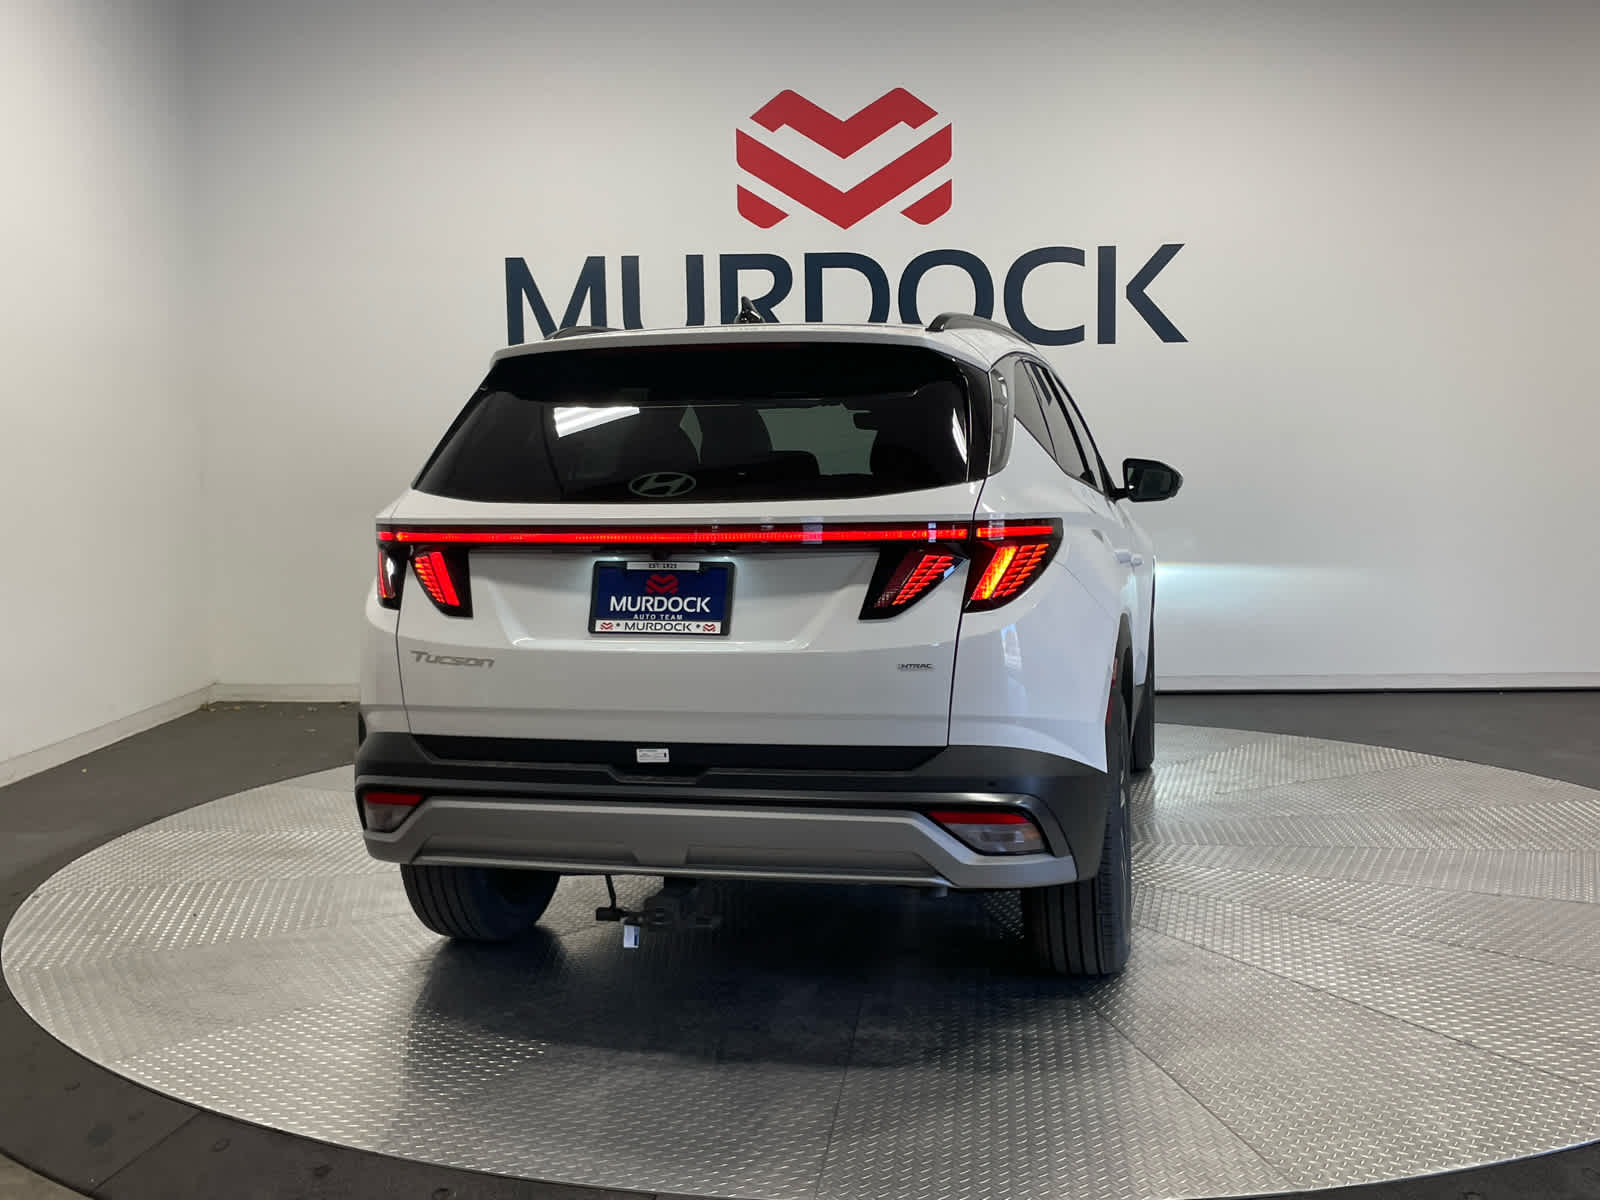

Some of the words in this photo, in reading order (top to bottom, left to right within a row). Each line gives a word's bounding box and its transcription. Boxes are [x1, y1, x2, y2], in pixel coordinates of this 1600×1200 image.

[504, 243, 1189, 346] MURDOCK
[610, 595, 711, 613] MURDOCK
[624, 622, 692, 632] MURDOCK
[410, 650, 495, 668] Tucson
